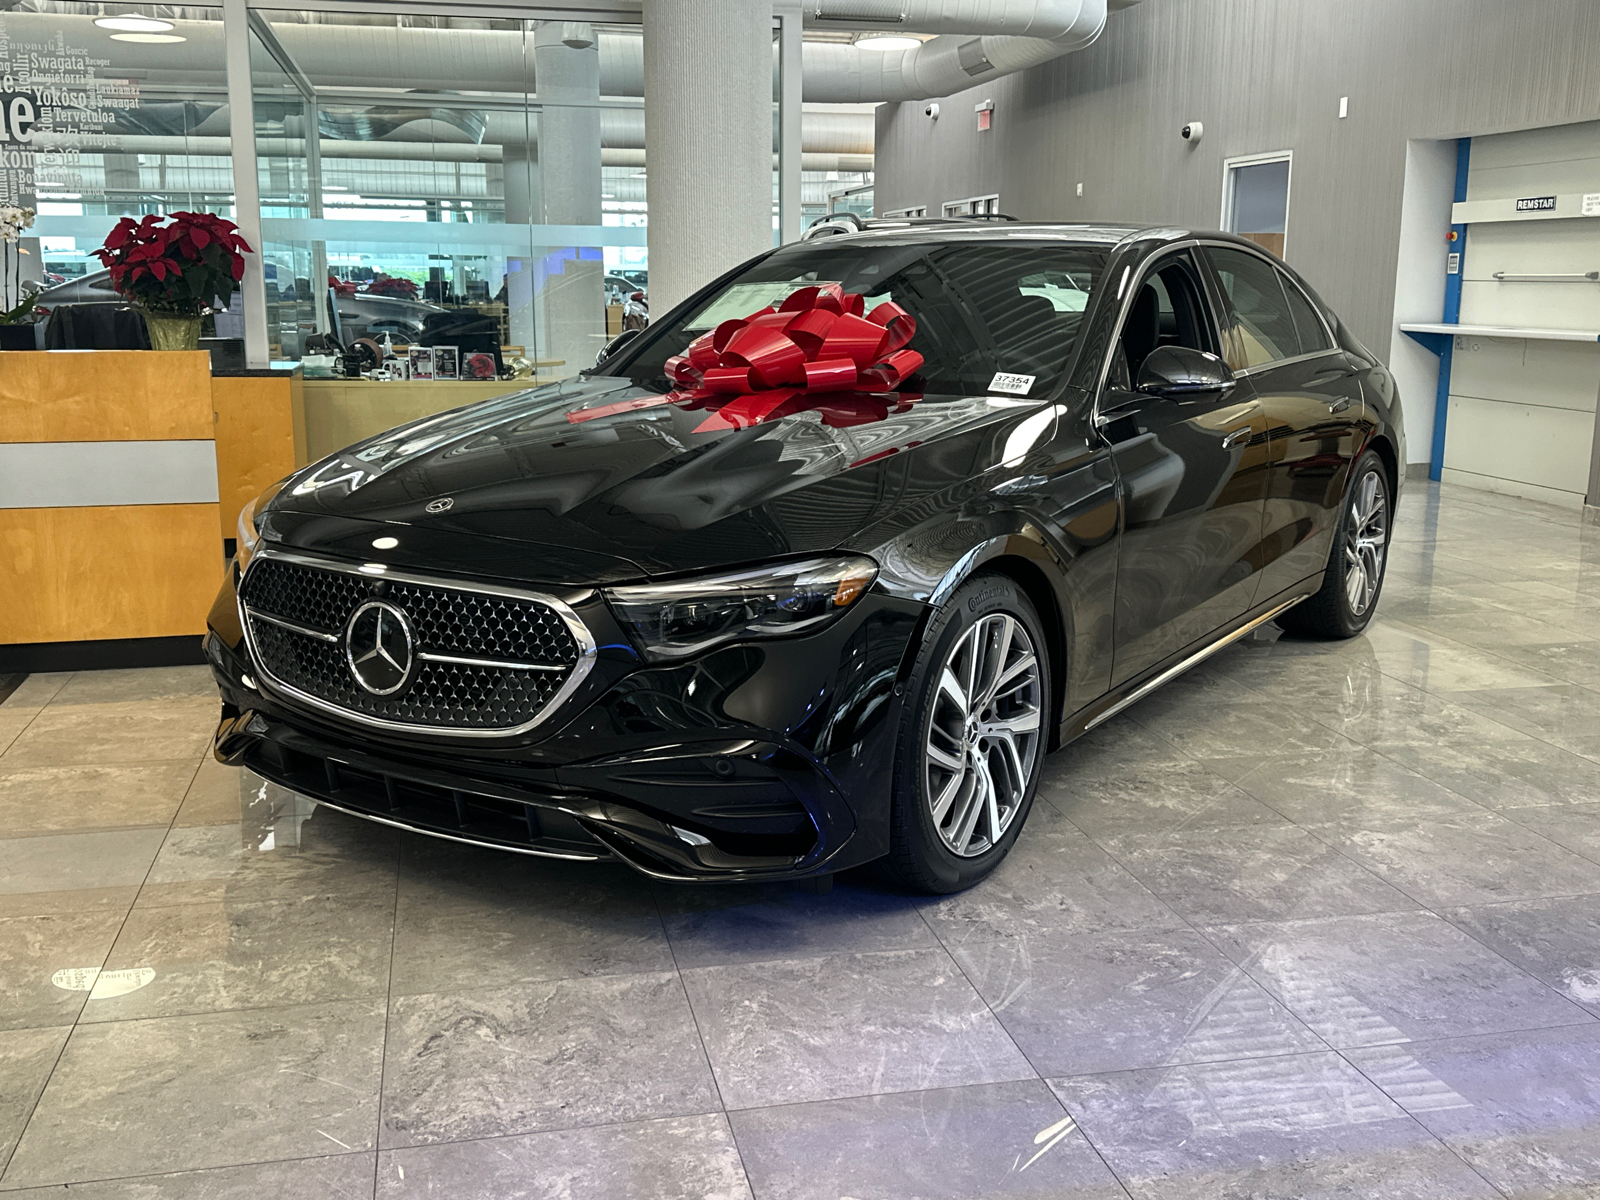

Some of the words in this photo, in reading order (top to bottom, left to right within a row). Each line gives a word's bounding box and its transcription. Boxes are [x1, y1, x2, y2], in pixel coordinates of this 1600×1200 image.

[31, 52, 85, 72] Swagata
[85, 56, 110, 67] Recoger
[12, 52, 31, 94] Acollir
[32, 85, 87, 106] Yokôso
[96, 83, 140, 95] Laukiamas
[97, 94, 139, 110] Swaagat
[54, 106, 116, 123] Tervetuloa
[1517, 199, 1554, 210] REMSTAR
[995, 375, 1029, 385] 37354
